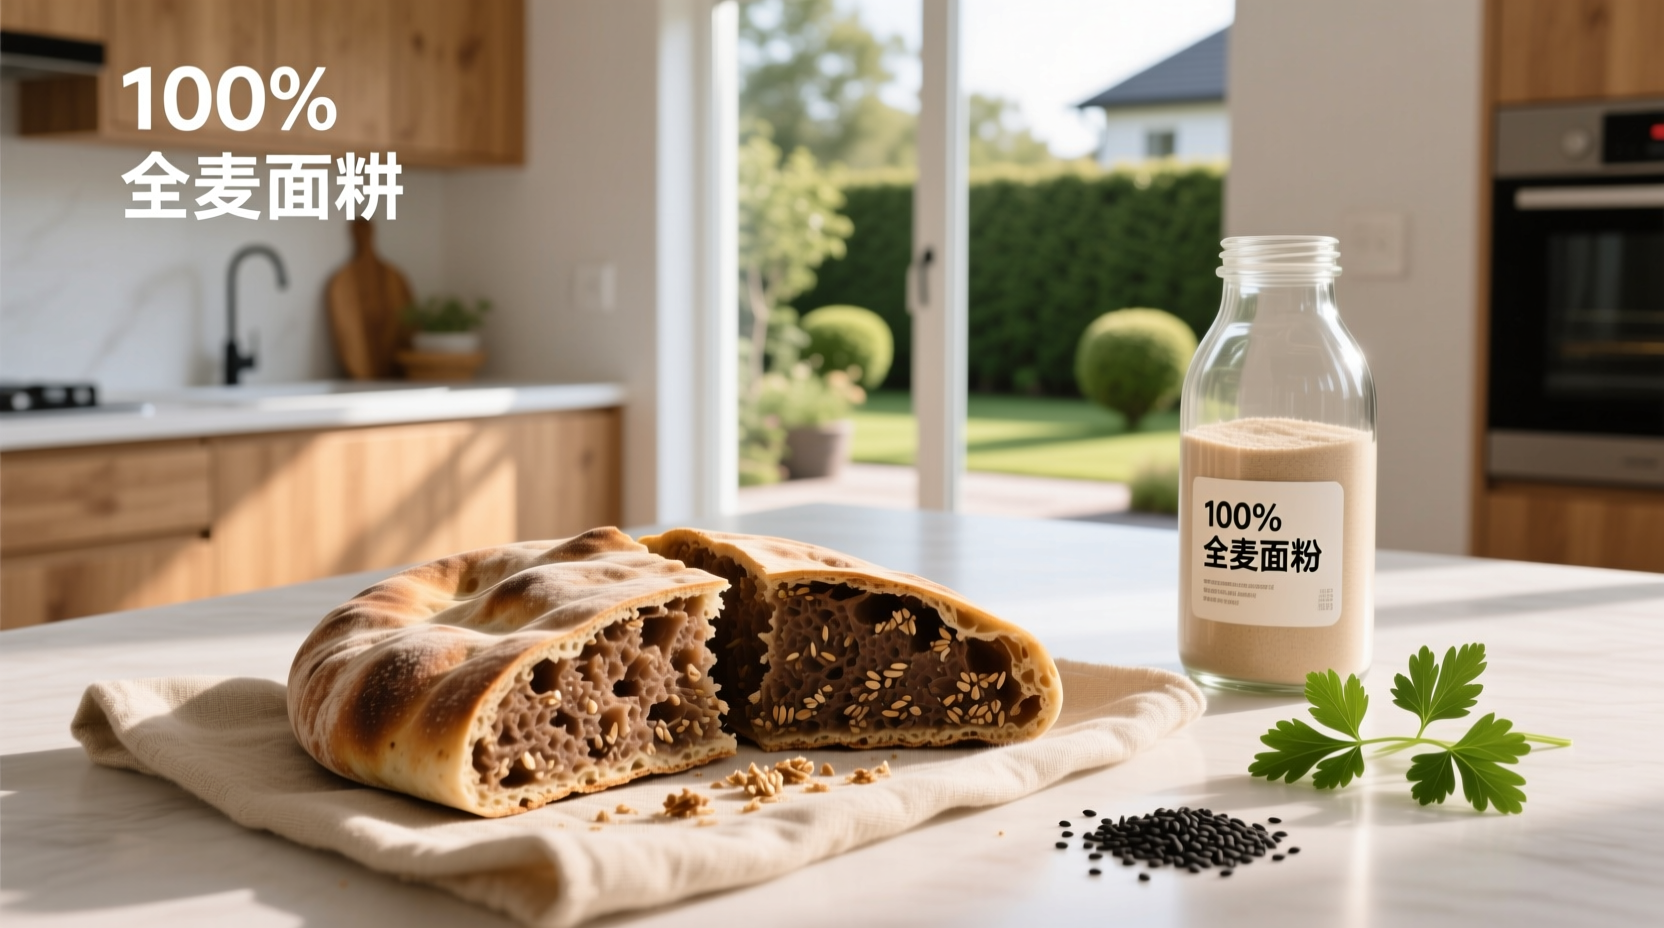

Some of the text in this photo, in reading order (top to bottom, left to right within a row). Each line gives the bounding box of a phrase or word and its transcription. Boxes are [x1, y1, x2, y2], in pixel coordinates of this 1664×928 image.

[1204, 500, 1282, 532] 100%
[1203, 535, 1322, 573] 全麦面粉
